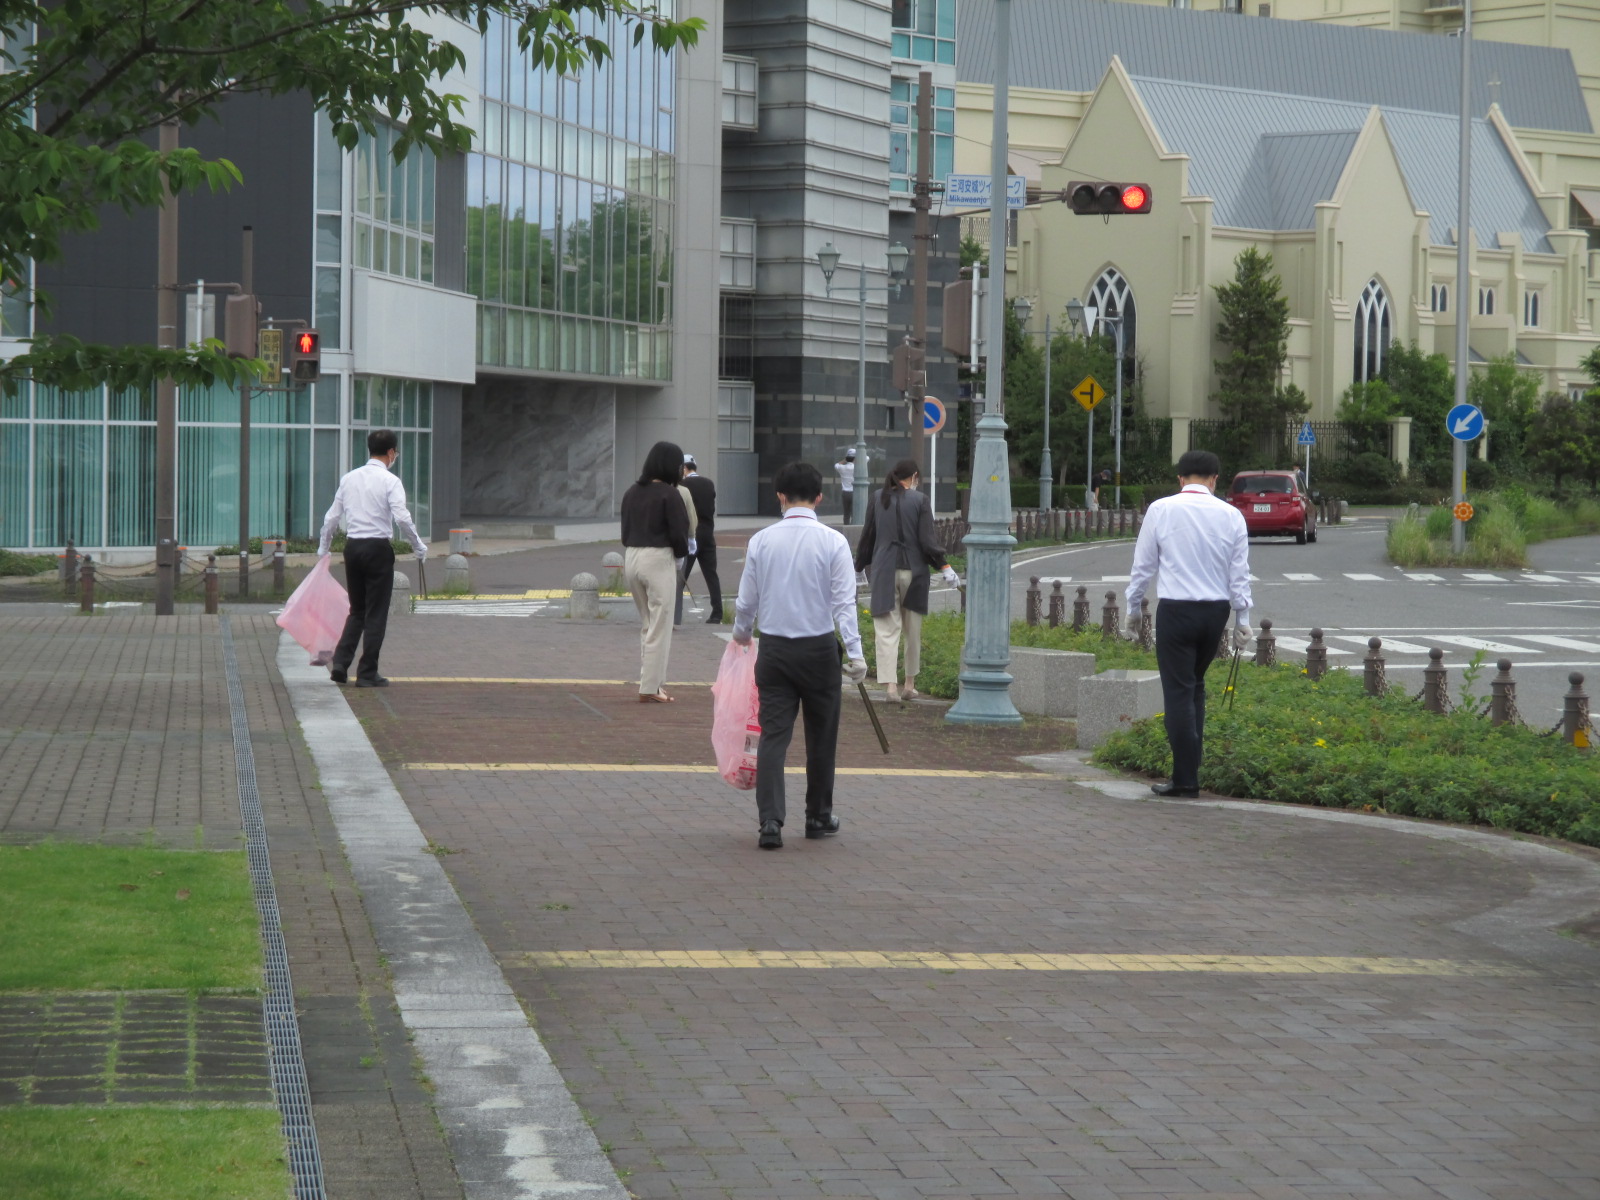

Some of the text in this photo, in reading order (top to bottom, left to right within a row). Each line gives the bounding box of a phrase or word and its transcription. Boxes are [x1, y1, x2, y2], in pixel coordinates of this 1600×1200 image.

[951, 179, 1021, 194] 三河安城ツイーク
